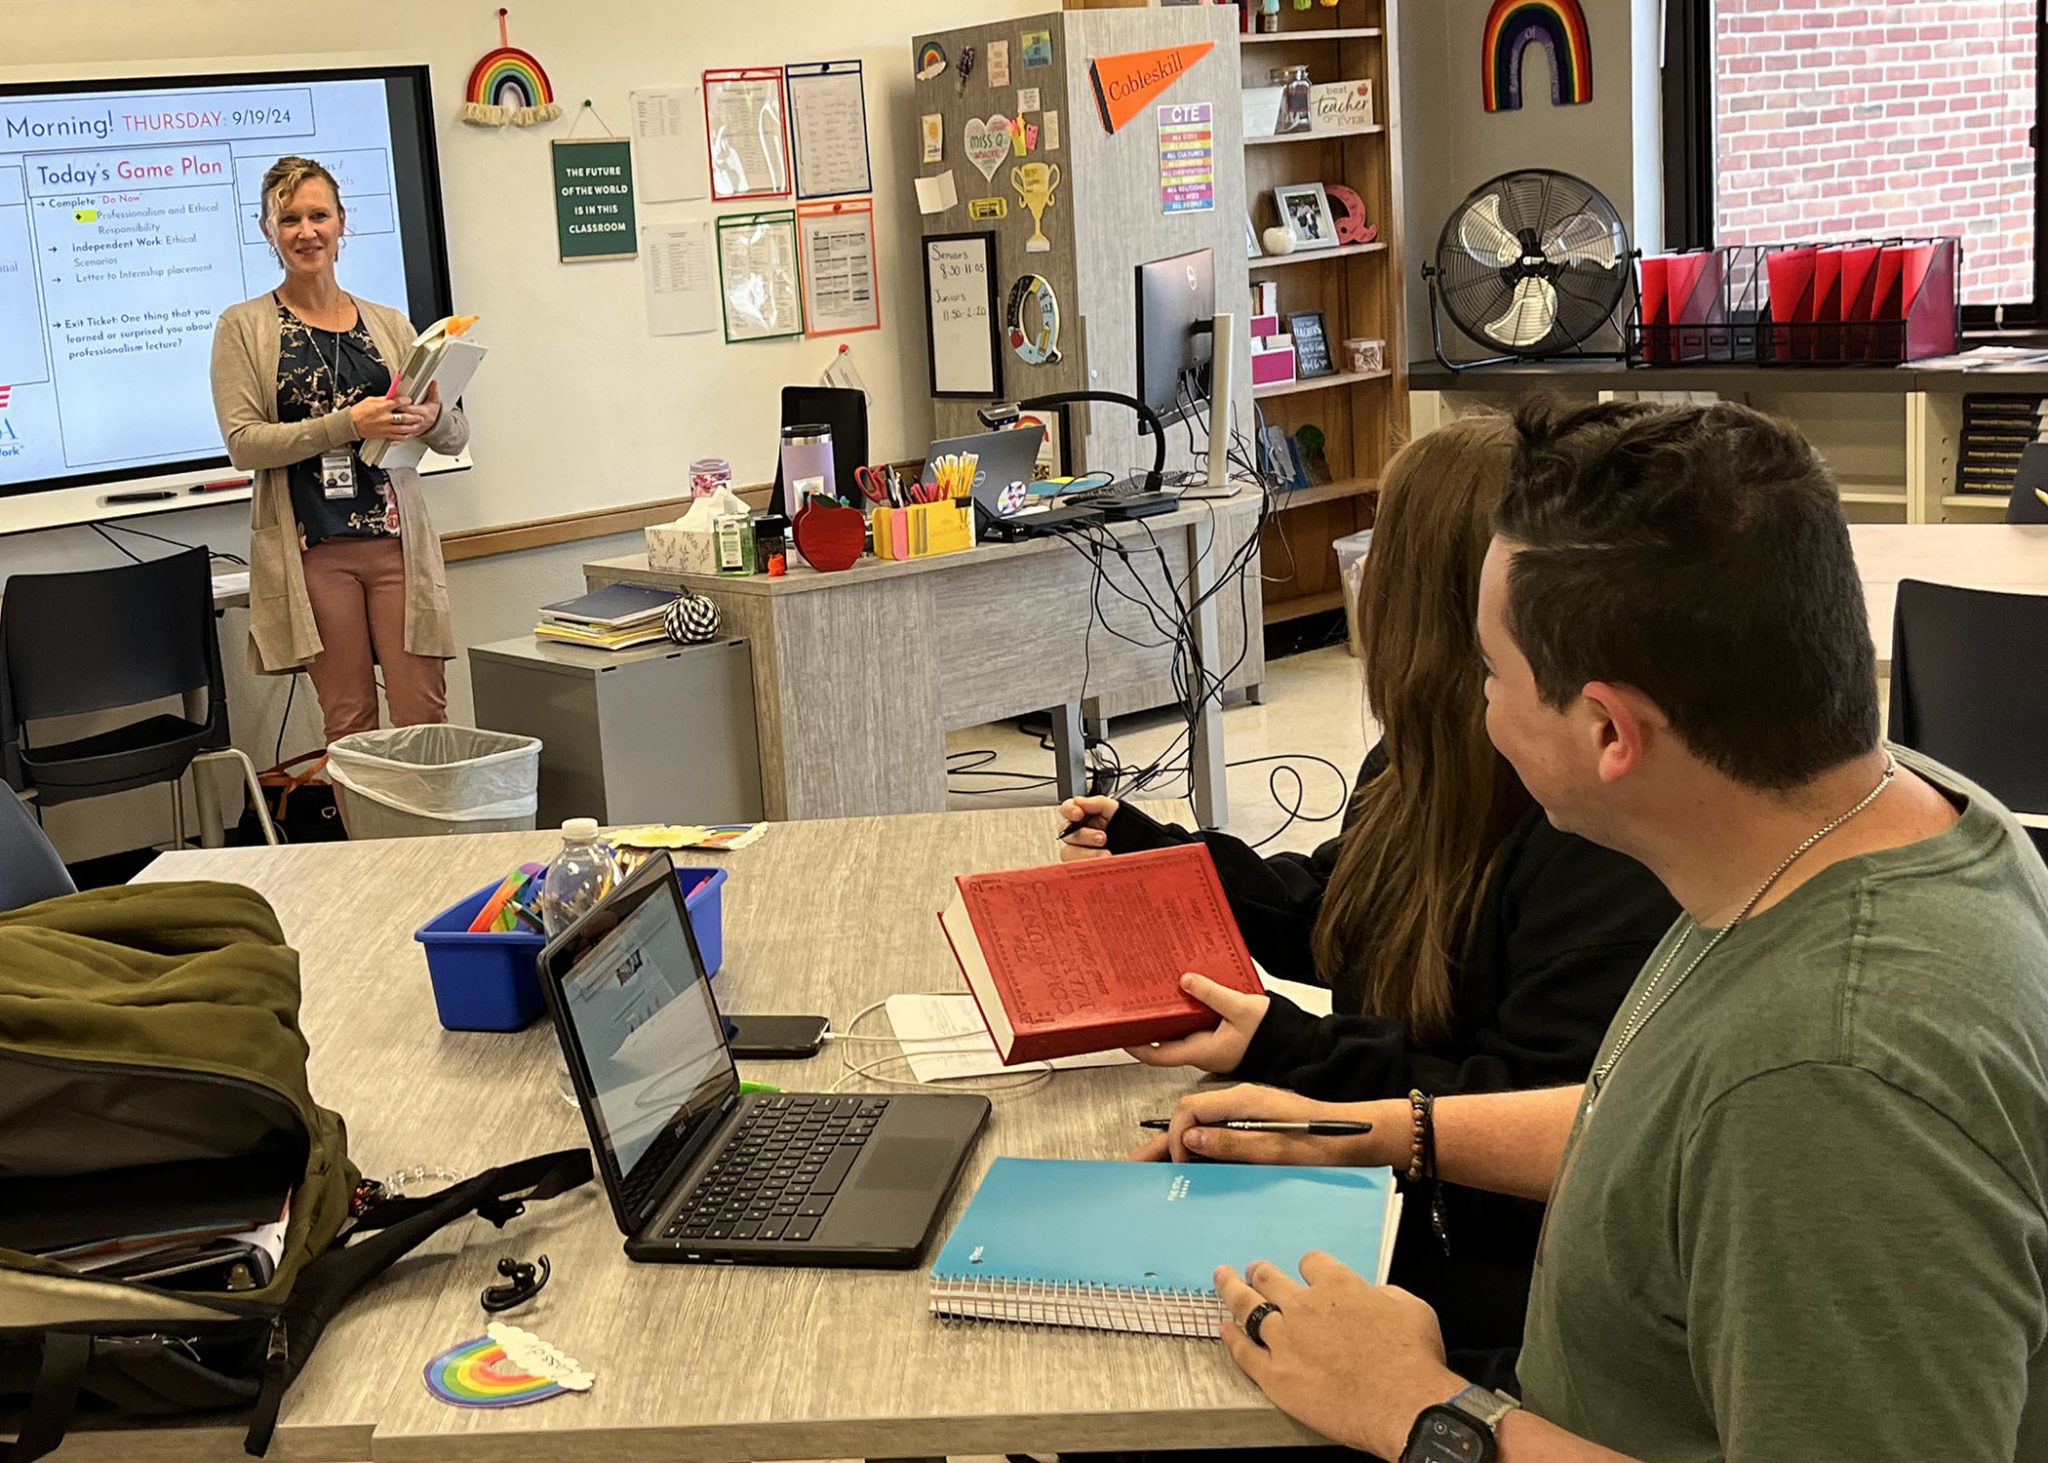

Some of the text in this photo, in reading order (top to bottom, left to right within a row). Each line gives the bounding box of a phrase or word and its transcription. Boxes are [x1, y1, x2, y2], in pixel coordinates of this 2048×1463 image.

[1109, 51, 1184, 101] Cobleskill
[1326, 85, 1347, 95] best
[1311, 91, 1369, 116] teacher
[6, 107, 291, 139] Morning! THURSDAY: 9/19/24
[1172, 106, 1200, 123] CTE
[37, 156, 223, 186] Today's Game Plan
[566, 166, 621, 177] THE FUTURE
[561, 185, 628, 196] OF THE WORLD
[49, 197, 96, 211] Complete
[97, 202, 219, 220] Professionalism and Ethical
[575, 205, 618, 215] IS IN THIS
[98, 222, 160, 237] Responsibility
[569, 222, 626, 233] CLASSROOM
[72, 239, 133, 254] Independent
[166, 234, 197, 244] Ethical
[931, 244, 969, 261] Seniors
[74, 256, 118, 268] Scenarios
[76, 263, 213, 284] Letter to Internship placement
[934, 289, 966, 303] Juniors
[64, 318, 84, 330] Exit
[120, 313, 141, 323] One
[144, 310, 169, 322] thing
[172, 308, 191, 319] that
[194, 308, 211, 320] you
[66, 322, 213, 344] learned or surprised you about
[68, 339, 182, 361] professionalism lecture?
